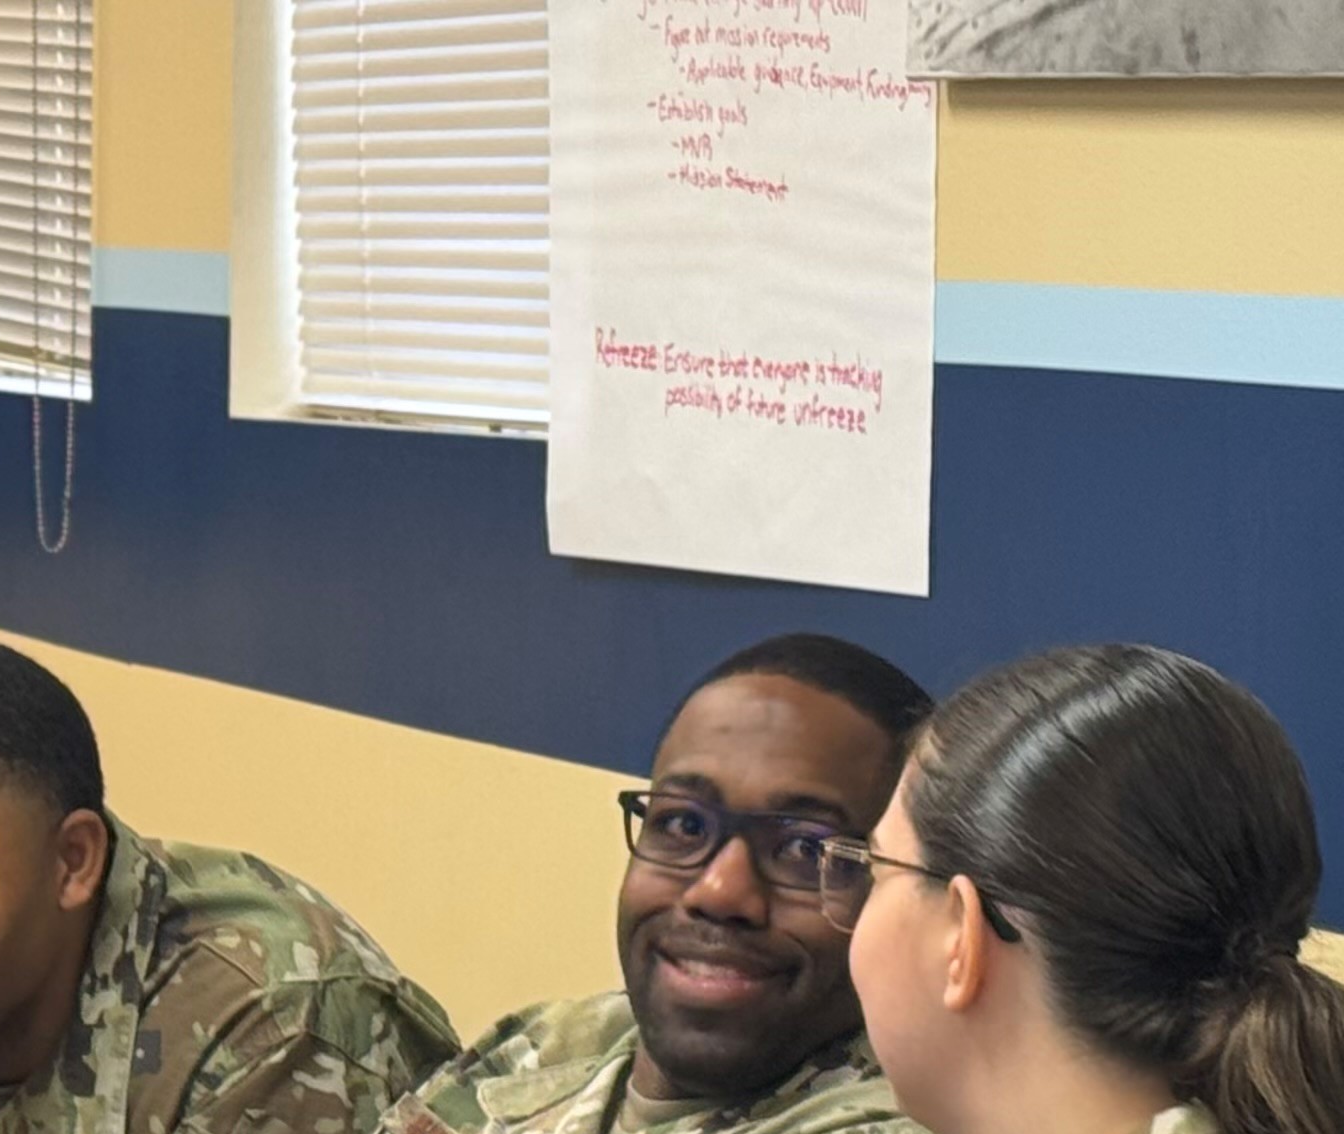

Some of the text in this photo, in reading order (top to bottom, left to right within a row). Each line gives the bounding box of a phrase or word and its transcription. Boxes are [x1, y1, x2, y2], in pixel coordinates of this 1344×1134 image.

[664, 342, 715, 379] Ensure
[718, 348, 749, 379] that
[753, 355, 810, 395] everyone
[726, 383, 742, 413] of
[793, 392, 868, 435] unfreeze
